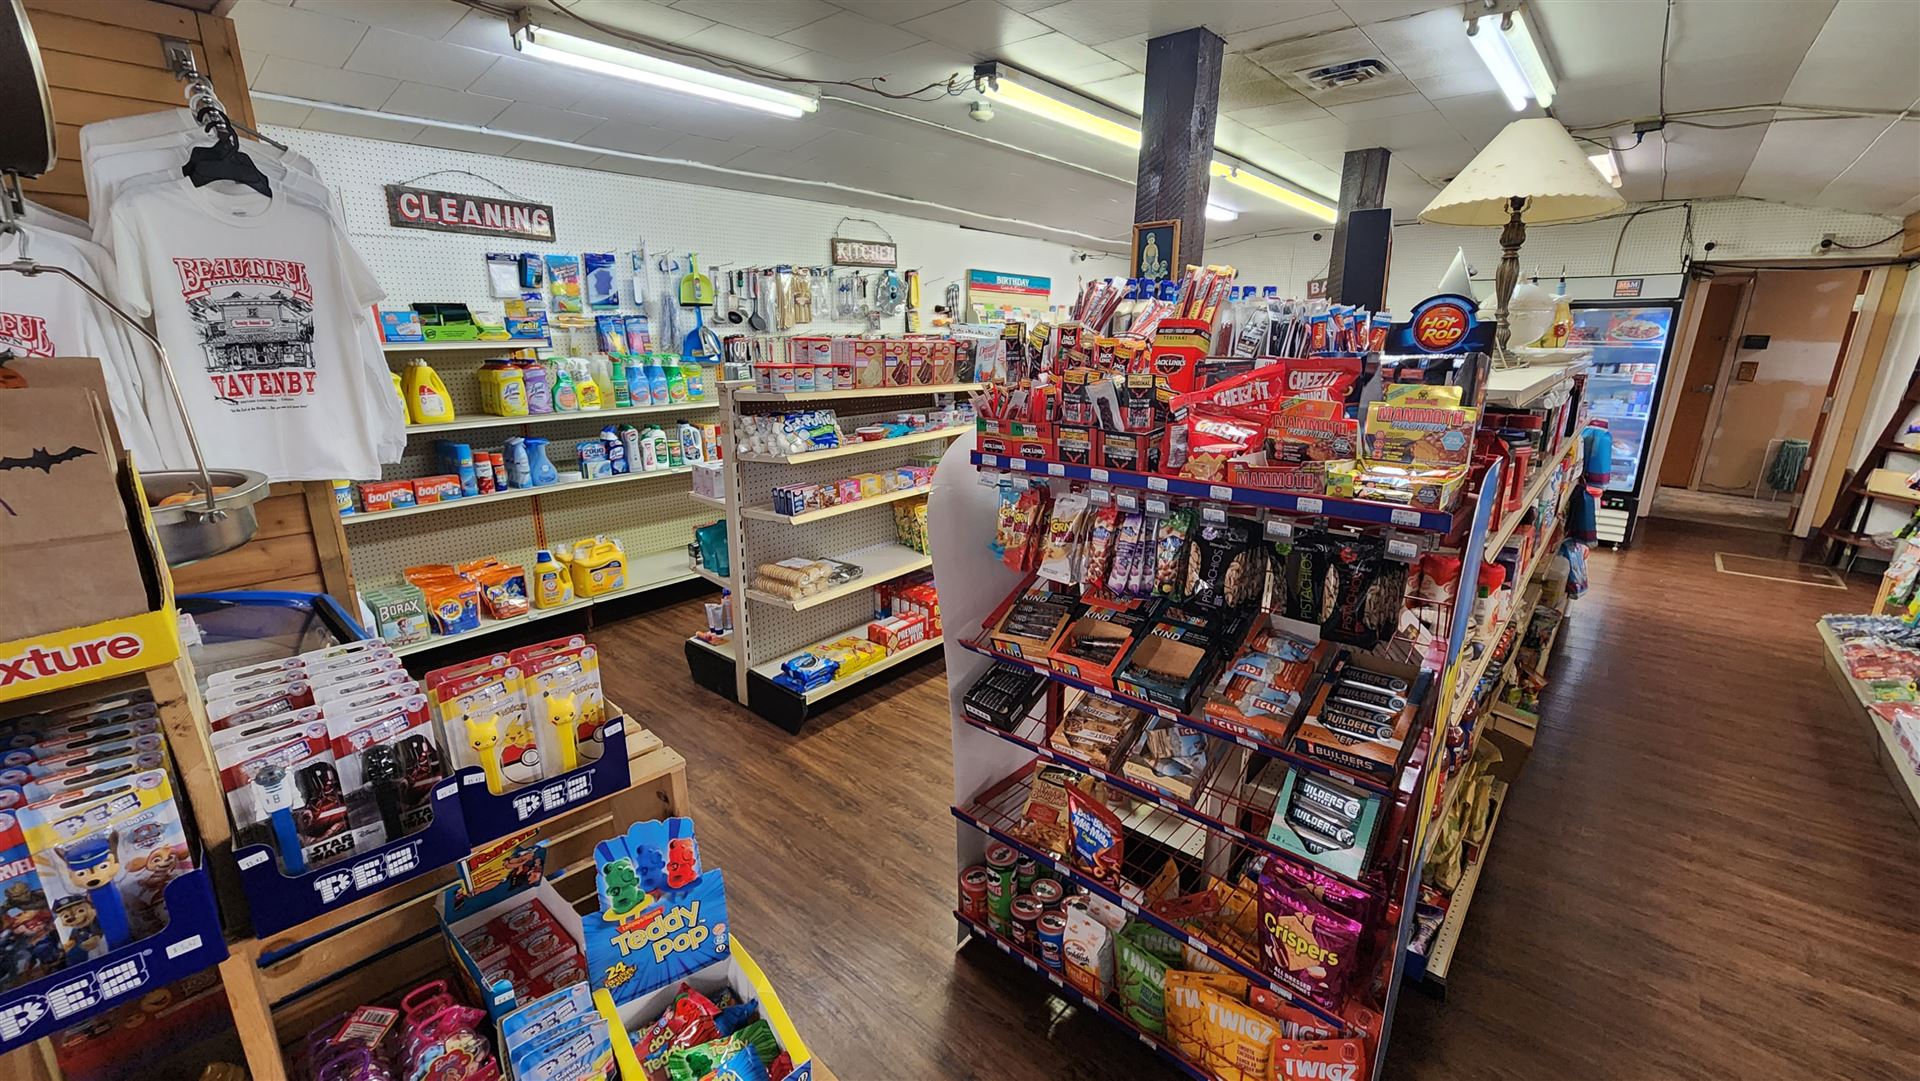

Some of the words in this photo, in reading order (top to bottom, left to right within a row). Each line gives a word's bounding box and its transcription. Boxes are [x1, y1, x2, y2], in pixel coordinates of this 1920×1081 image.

[399, 192, 552, 237] CLEANING
[837, 242, 895, 266] KITCHEN
[173, 258, 314, 304] BEAUTIFUL
[210, 278, 291, 289] DOWNTOWN
[996, 276, 1030, 287] BIRTHDAY
[211, 372, 317, 399] VAVENBY
[503, 382, 519, 396] Lysol
[530, 381, 545, 395] Lysol
[1275, 415, 1348, 434] MAMMOTH
[1378, 406, 1464, 427] MAMMOTH
[1391, 421, 1447, 433] PROTEIN
[1287, 427, 1334, 441] PROTEIN
[418, 481, 454, 498] bounce
[1236, 470, 1315, 489] MAMMOTH
[368, 487, 405, 505] bounce
[1051, 518, 1073, 532] CORN
[1201, 549, 1224, 602] PISTACHIOS
[1300, 552, 1313, 619] PISTACHIOS
[438, 601, 460, 619] Tide
[1023, 594, 1049, 604] KIND
[378, 599, 421, 623] BORAX
[1084, 610, 1111, 622] KIND
[897, 621, 924, 641] PREMIUM
[910, 633, 925, 645] PLUS
[1151, 627, 1181, 641] KIND
[0, 636, 140, 686] xture
[1345, 669, 1390, 687] UILDERS
[1261, 701, 1284, 714] CLIF
[348, 713, 410, 751] PEZ
[1219, 720, 1246, 735] CLIF
[1316, 746, 1374, 771] BUILDERS
[513, 774, 592, 821] PEZ
[1303, 783, 1345, 808] UILDERS
[409, 806, 433, 819] STA
[310, 841, 356, 864] WARS
[311, 832, 354, 855] STAR
[0, 858, 36, 881] RVEL
[314, 840, 423, 905] PEZ
[611, 899, 701, 957] Teddy
[652, 924, 709, 964] pop
[1143, 934, 1182, 952] TWIG
[1265, 912, 1339, 967] Crispers
[1066, 947, 1090, 963] Goldfish
[605, 961, 627, 980] 24
[1274, 965, 1285, 976] ALL
[1284, 972, 1312, 991] DRESSED
[0, 950, 152, 1042] PEZ
[522, 999, 577, 1038] PEZ
[1208, 1003, 1274, 1046] TWIGZ
[538, 1032, 595, 1076] PEZ
[1284, 1057, 1359, 1081] TWIGZ
